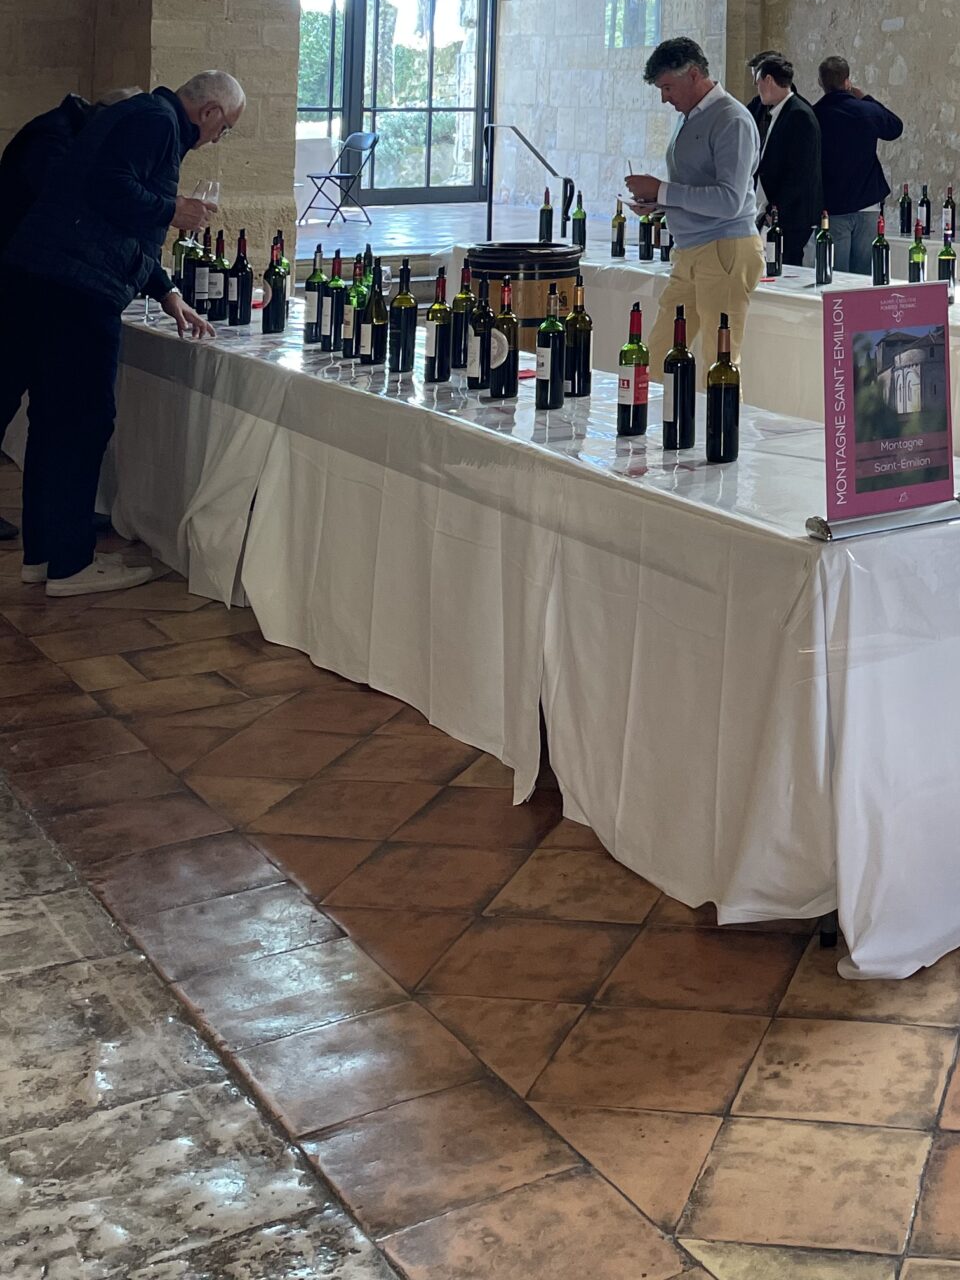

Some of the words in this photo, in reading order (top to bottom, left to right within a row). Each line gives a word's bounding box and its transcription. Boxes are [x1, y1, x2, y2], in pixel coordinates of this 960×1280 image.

[833, 298, 846, 411] SAINT-EMILION
[835, 415, 847, 505] MONTAGNE
[880, 438, 924, 451] Montagne
